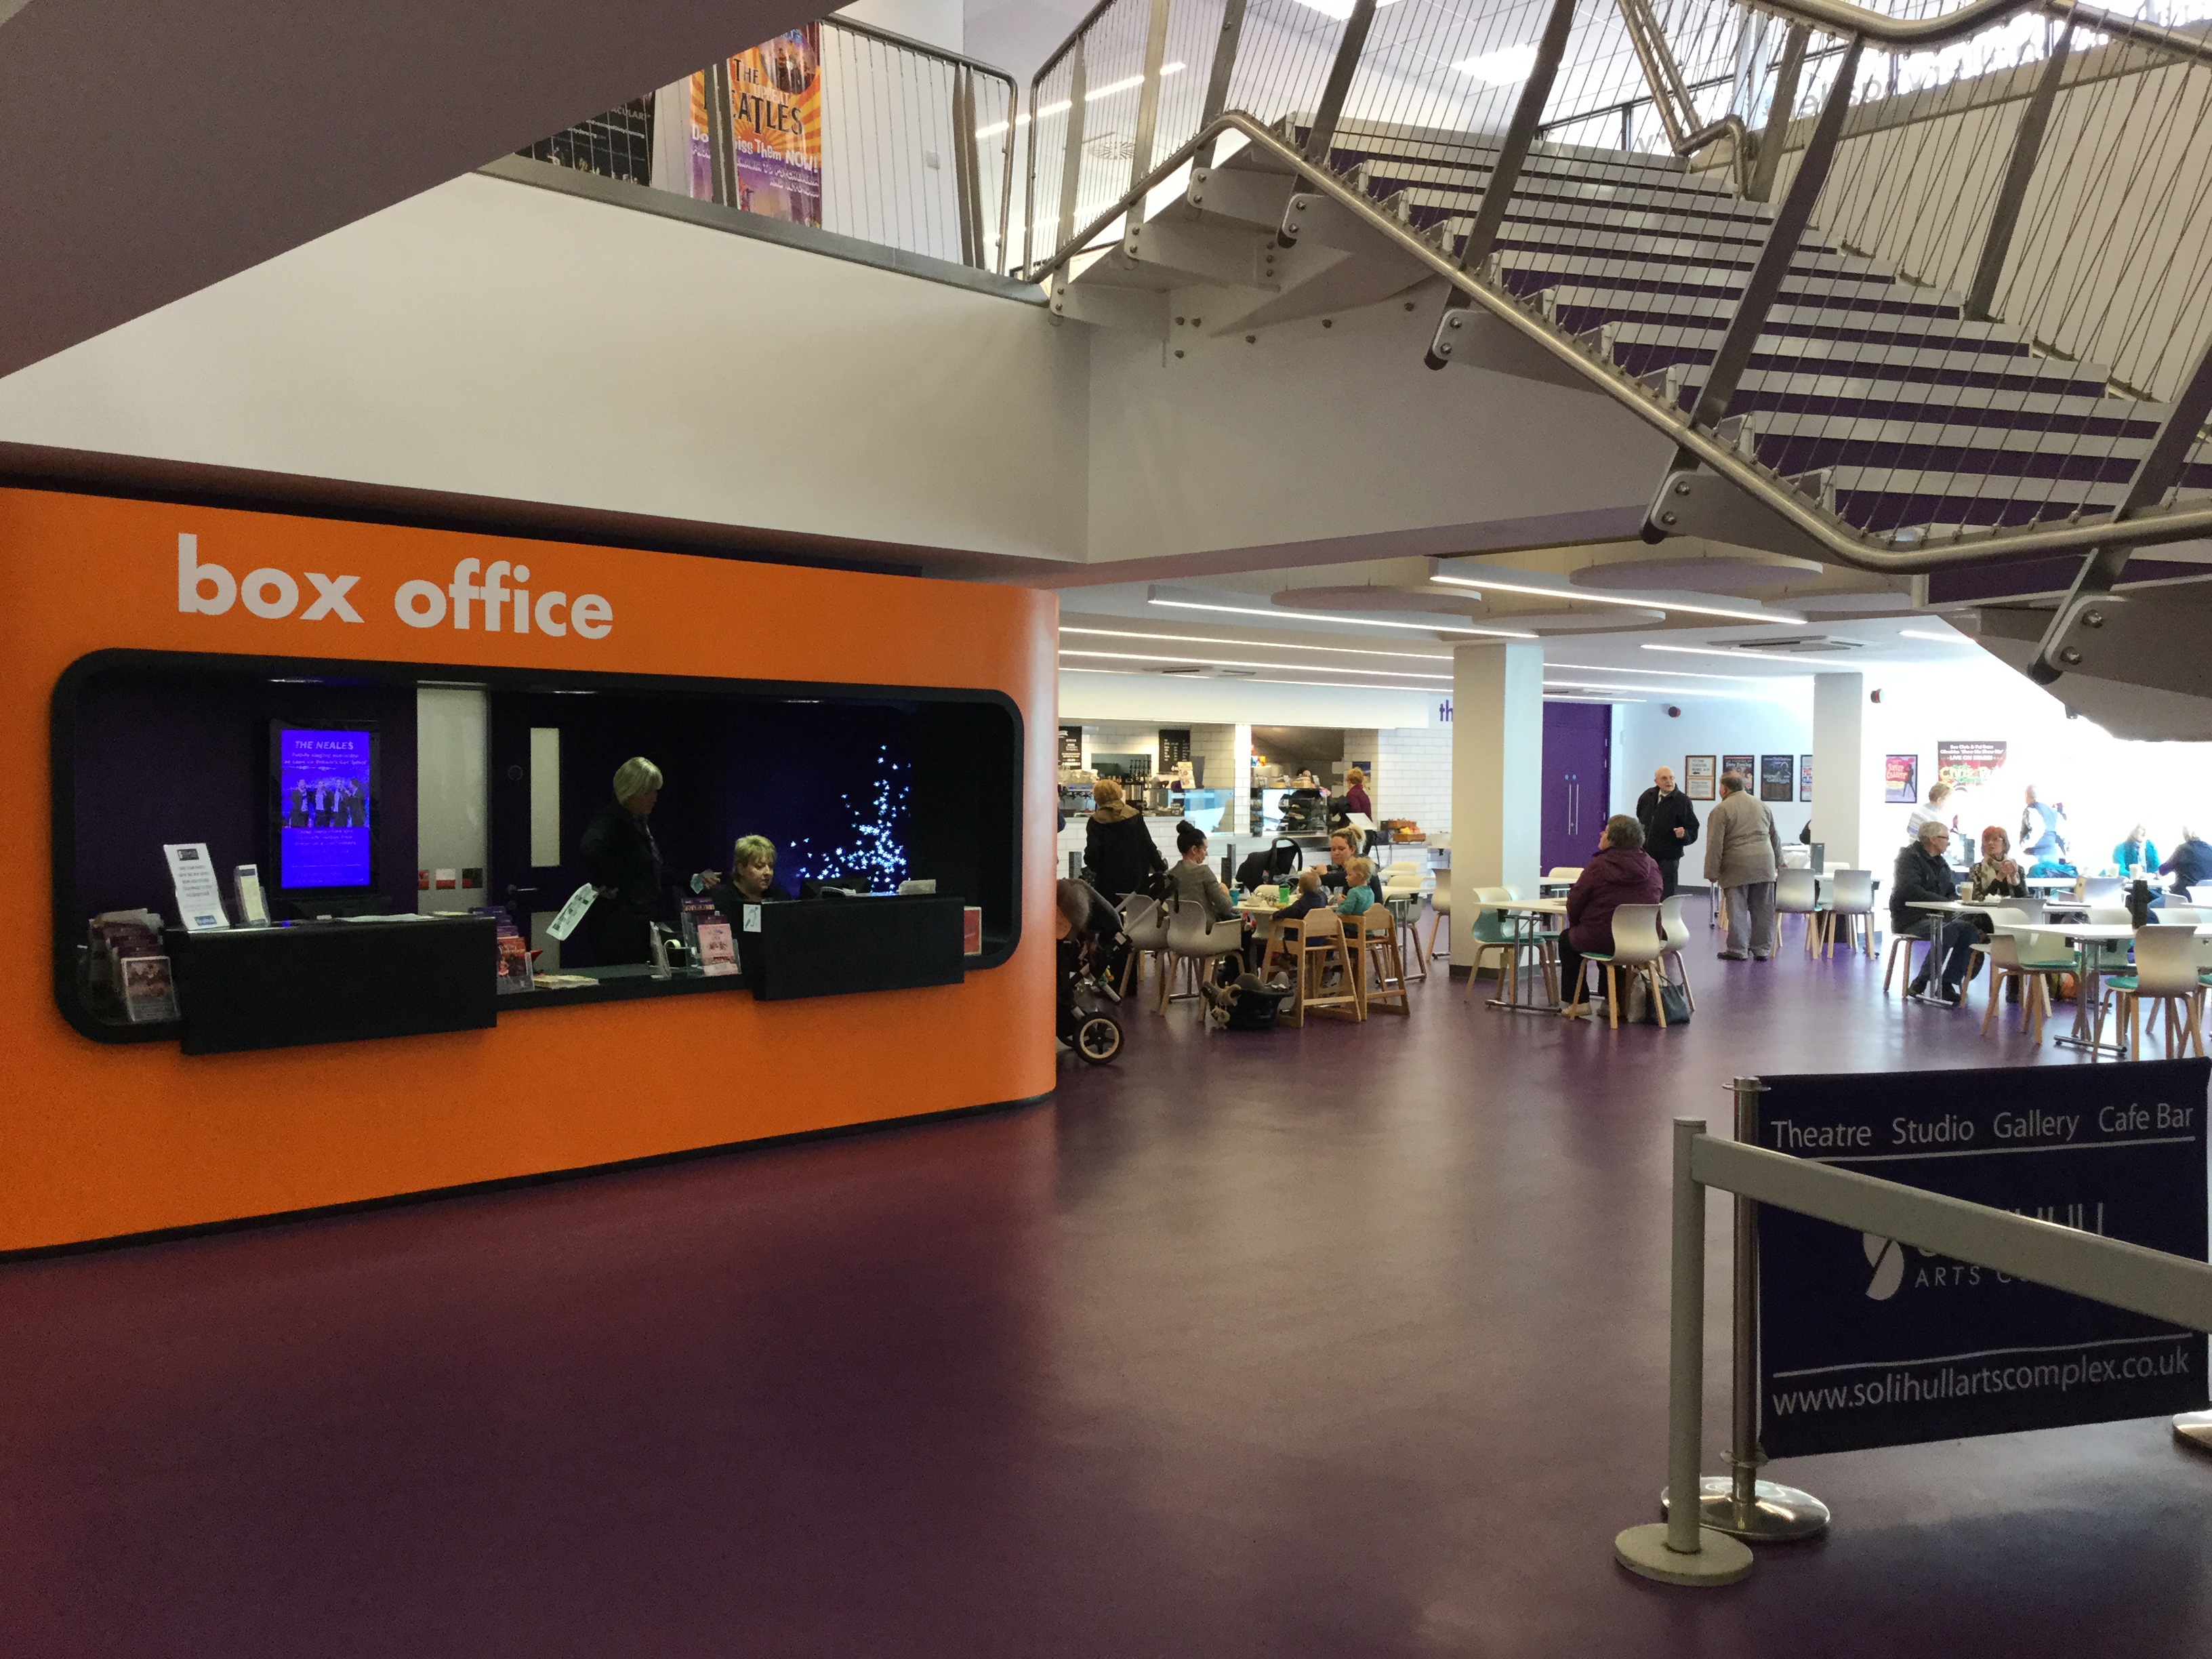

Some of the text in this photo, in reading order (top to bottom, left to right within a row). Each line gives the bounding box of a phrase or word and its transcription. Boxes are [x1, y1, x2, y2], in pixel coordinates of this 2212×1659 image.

[734, 58, 759, 85] THE
[735, 136, 754, 155] iss
[754, 138, 782, 161] Them
[785, 150, 819, 173] NOW!
[178, 532, 614, 640] box office
[1439, 699, 1454, 722] th
[295, 740, 314, 750] THE
[1770, 1103, 2194, 1148] Theatre Studio Gallery Cafe Bar
[1914, 1265, 1980, 1288] ARTS
[1772, 1345, 2190, 1416] www.solihullartscomplex.co.uk
